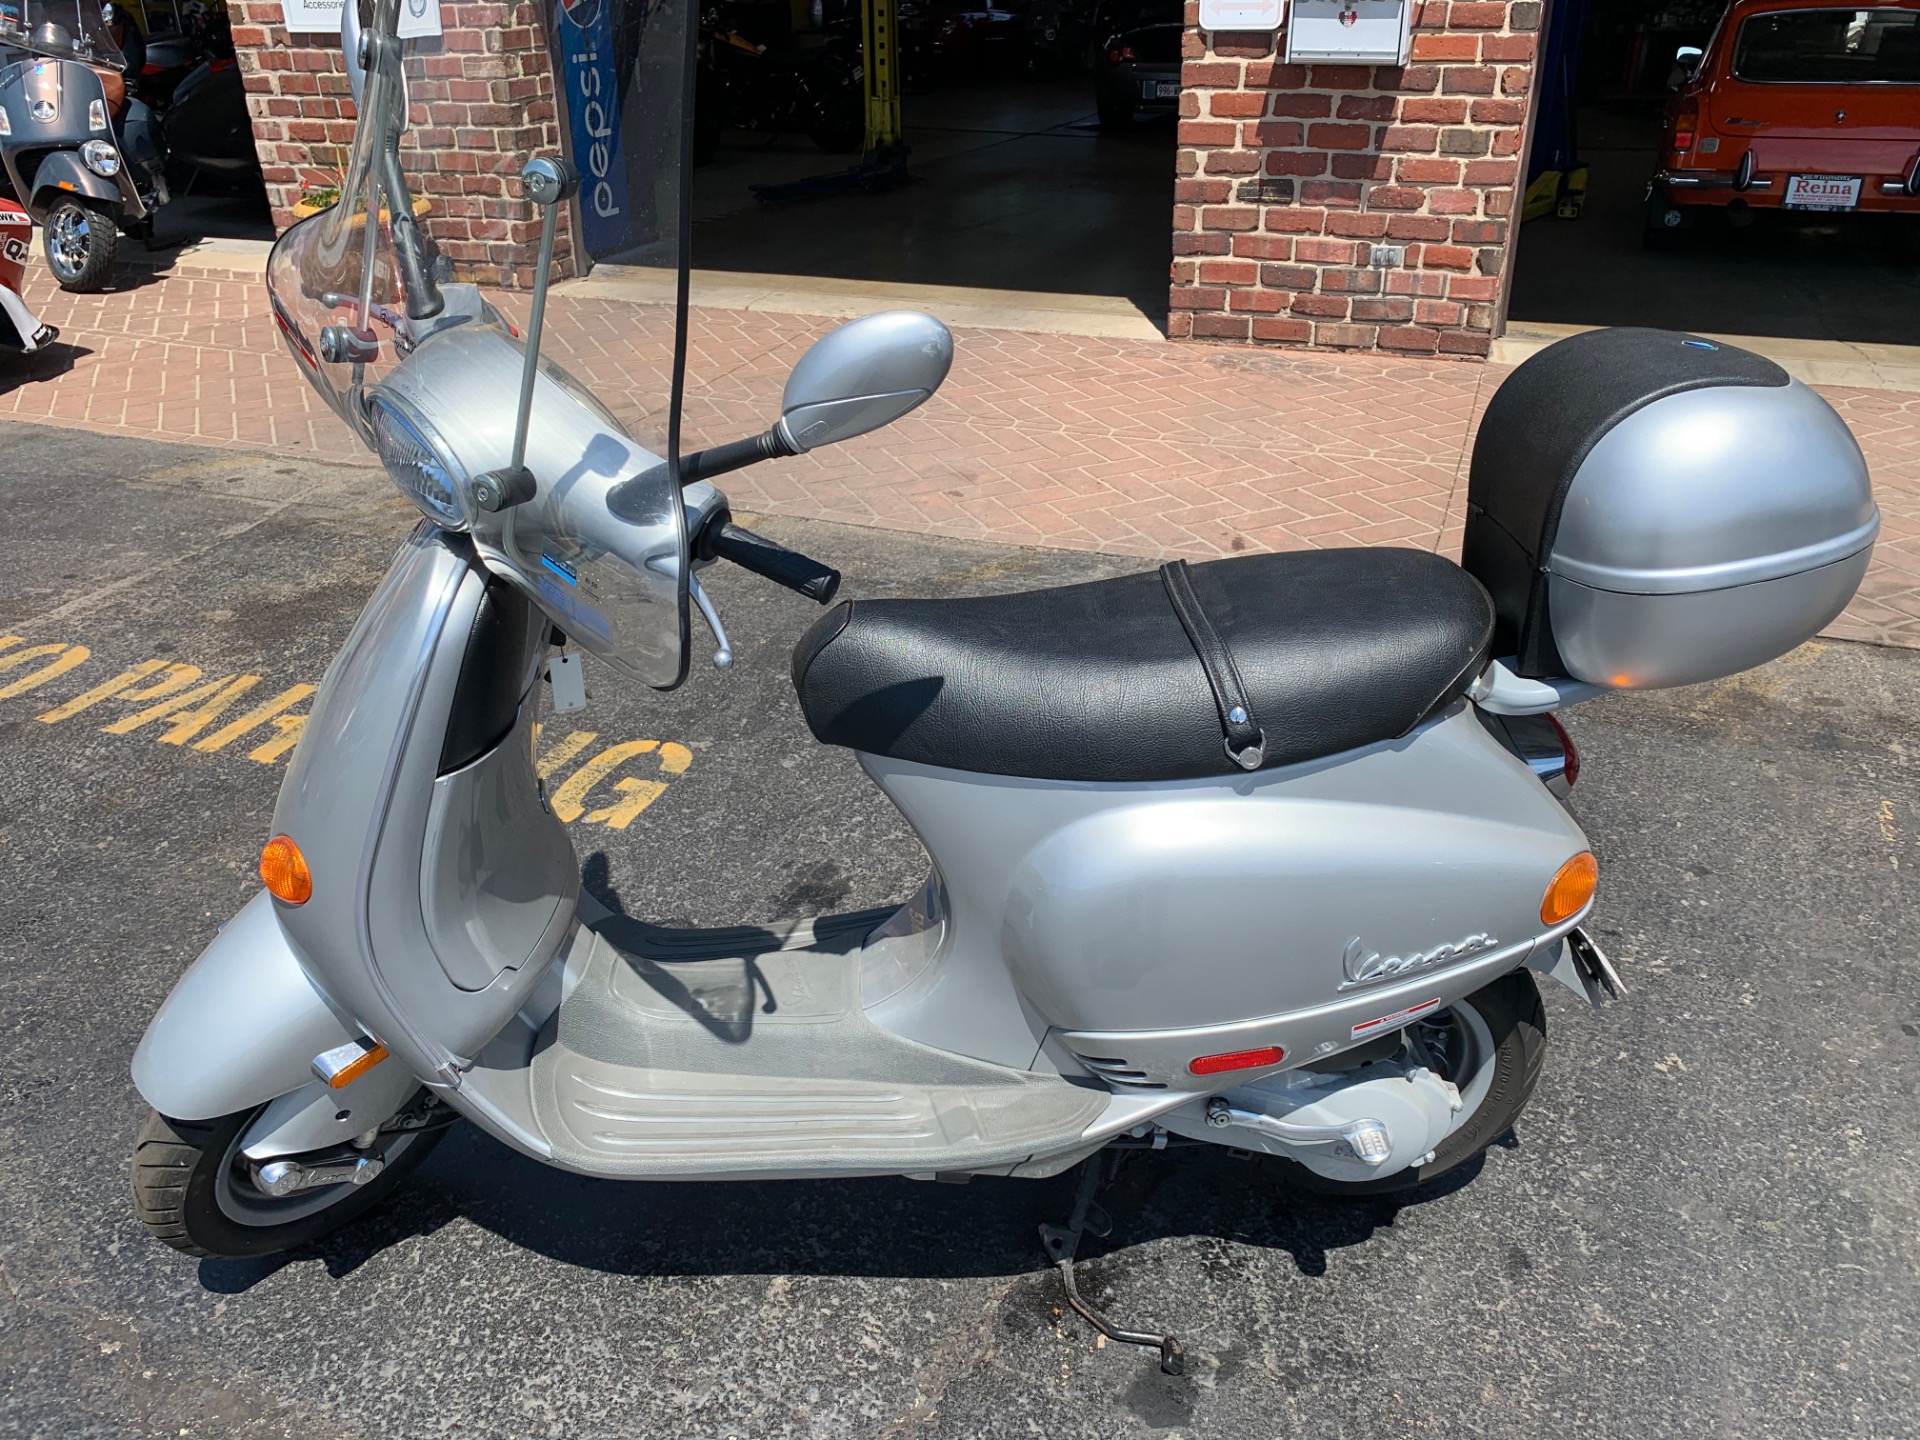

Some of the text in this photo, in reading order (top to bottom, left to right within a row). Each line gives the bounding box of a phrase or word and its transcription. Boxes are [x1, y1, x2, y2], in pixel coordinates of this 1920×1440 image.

[303, 0, 346, 9] Accessorie
[572, 52, 620, 218] pepsi
[1794, 179, 1852, 195] Reina
[0, 213, 16, 221] WK
[1337, 933, 1498, 993] Vespa
